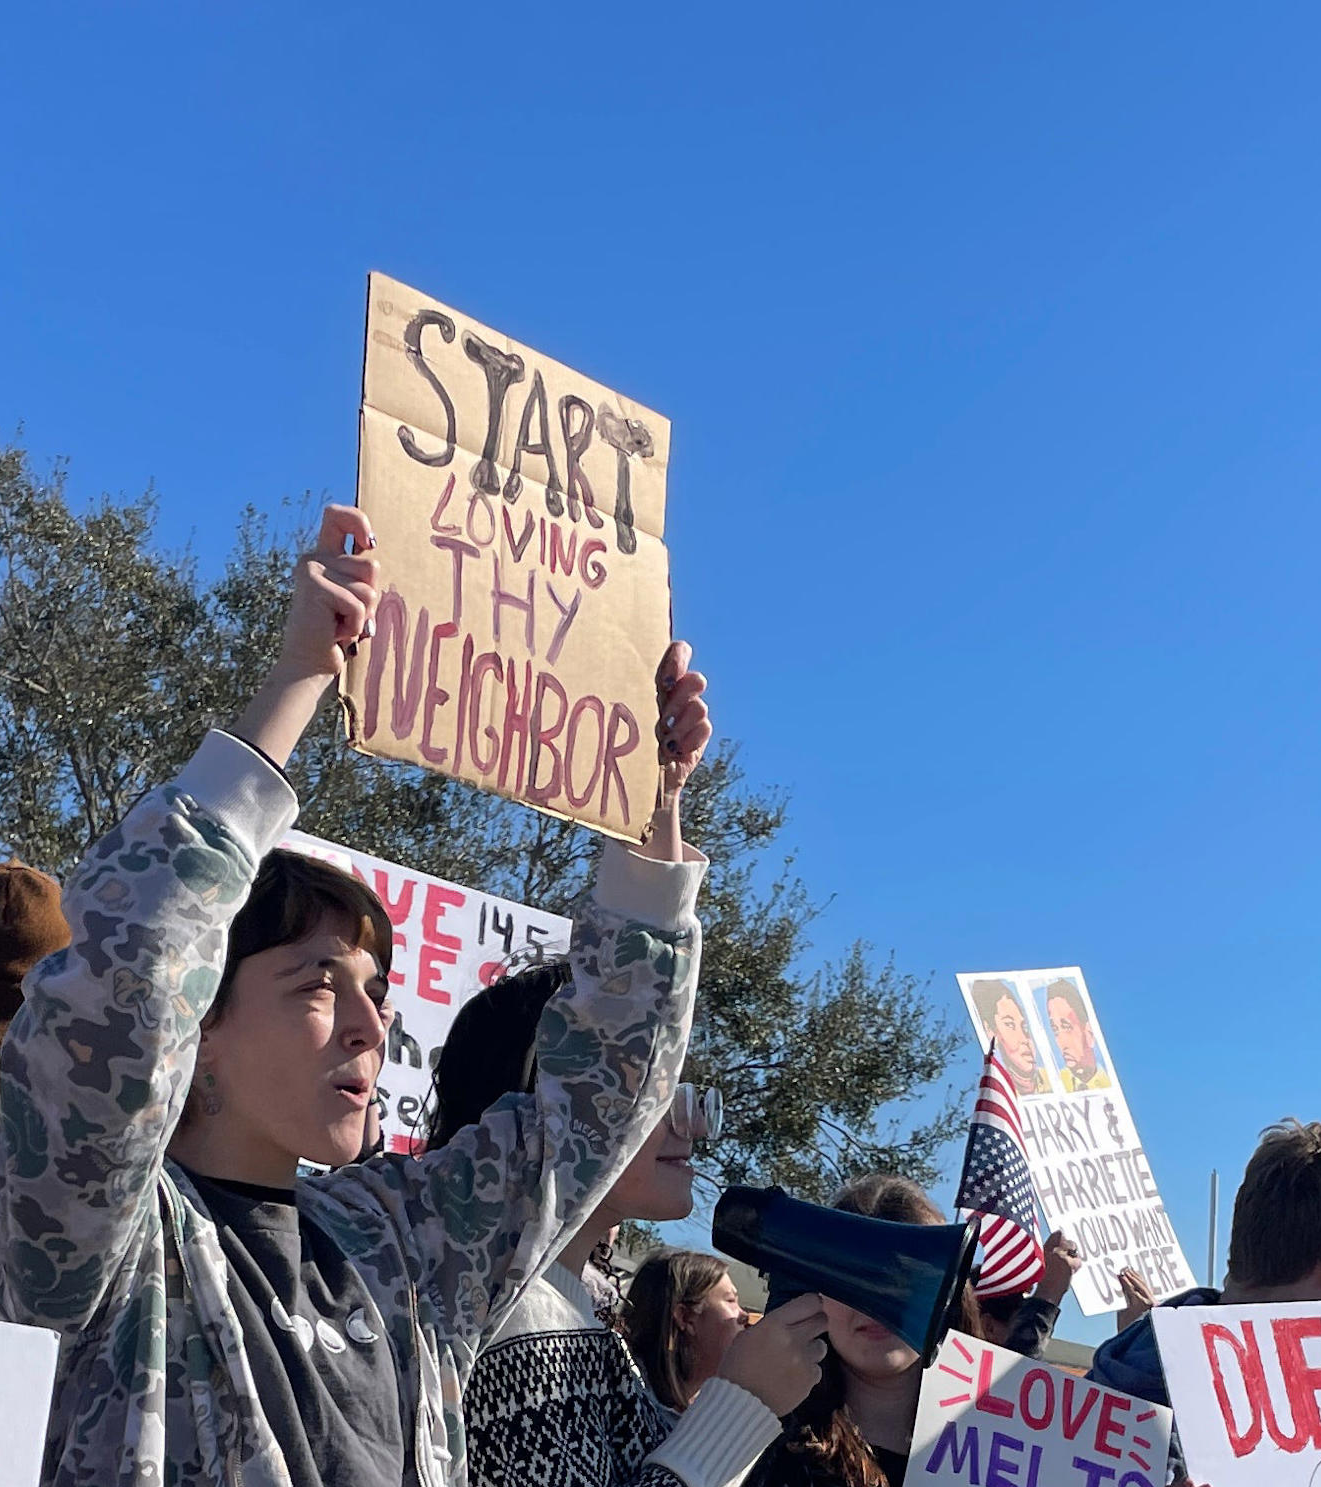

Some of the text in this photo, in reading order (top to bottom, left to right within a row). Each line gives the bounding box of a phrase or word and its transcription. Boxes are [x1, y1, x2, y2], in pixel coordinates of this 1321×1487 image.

[397, 308, 654, 555] START
[430, 472, 608, 590] LOVING
[430, 534, 583, 667] THY
[363, 584, 641, 826] NEIGHBOR
[1023, 1096, 1125, 1159] HARRY &
[1123, 1205, 1176, 1249] WANT
[975, 1349, 1132, 1460] LOVE
